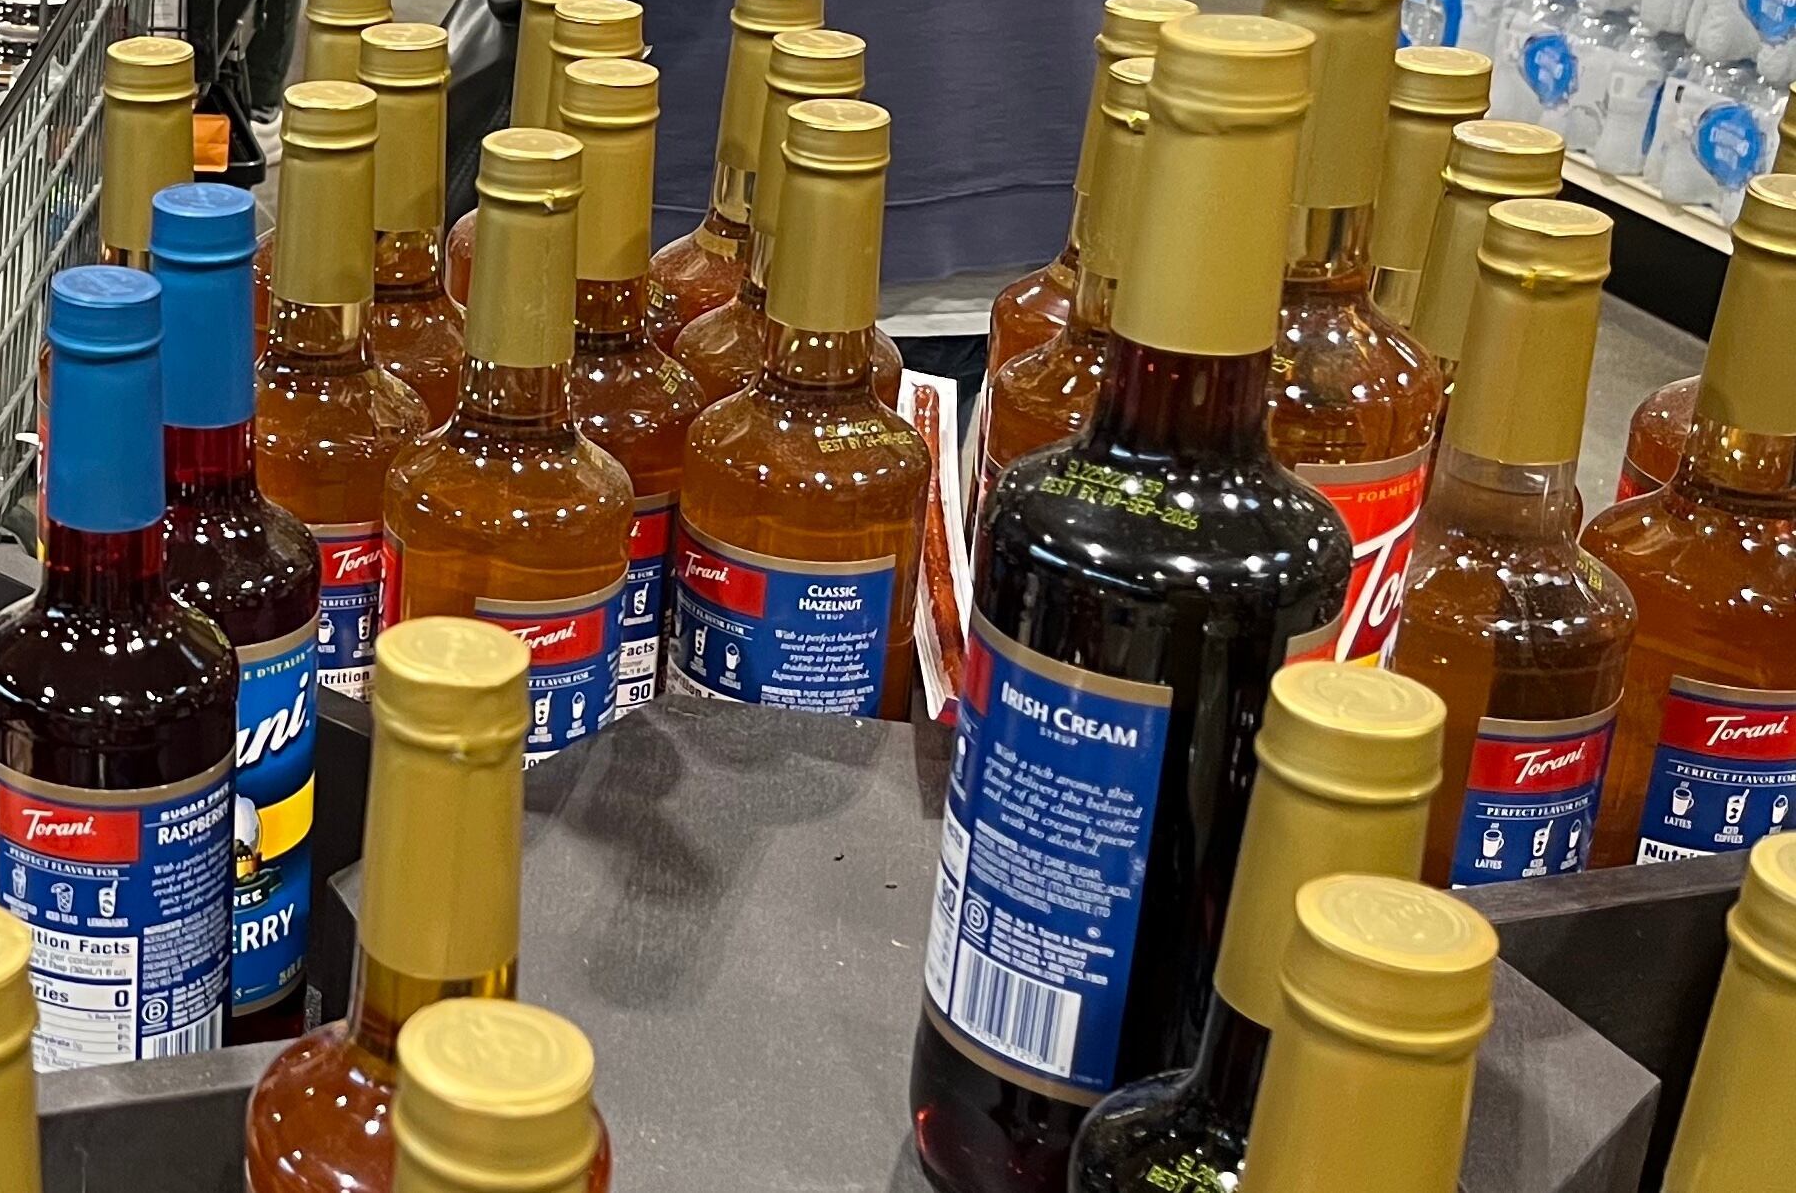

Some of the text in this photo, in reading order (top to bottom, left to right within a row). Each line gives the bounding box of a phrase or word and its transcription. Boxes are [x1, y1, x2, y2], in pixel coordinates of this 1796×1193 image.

[685, 550, 729, 582] Torani
[807, 584, 858, 598] CLASSIC
[799, 598, 863, 611] HAZELNUT
[815, 613, 844, 621] SYRUP
[629, 683, 651, 702] 90
[1001, 681, 1139, 748] IRISH CREAM
[1039, 726, 1079, 746] SYRUP
[1706, 715, 1789, 747] Torani
[1514, 741, 1586, 785] Torani
[1676, 764, 1729, 781] PERFECT
[1731, 774, 1775, 784] FLAVOR
[1012, 769, 1060, 799] delivers
[1060, 789, 1084, 806] the
[1085, 796, 1144, 819] beloved
[160, 798, 206, 822] SUGAR
[1027, 793, 1049, 809] the
[1049, 802, 1094, 824] classic
[1095, 818, 1140, 834] coffee
[1486, 806, 1536, 817] PERFECT
[21, 808, 95, 840] Torani
[157, 797, 230, 845] RASPBERRY
[1040, 816, 1082, 836] cream
[1027, 826, 1045, 839] no
[79, 939, 130, 955] Facts
[114, 990, 129, 1008] 0
